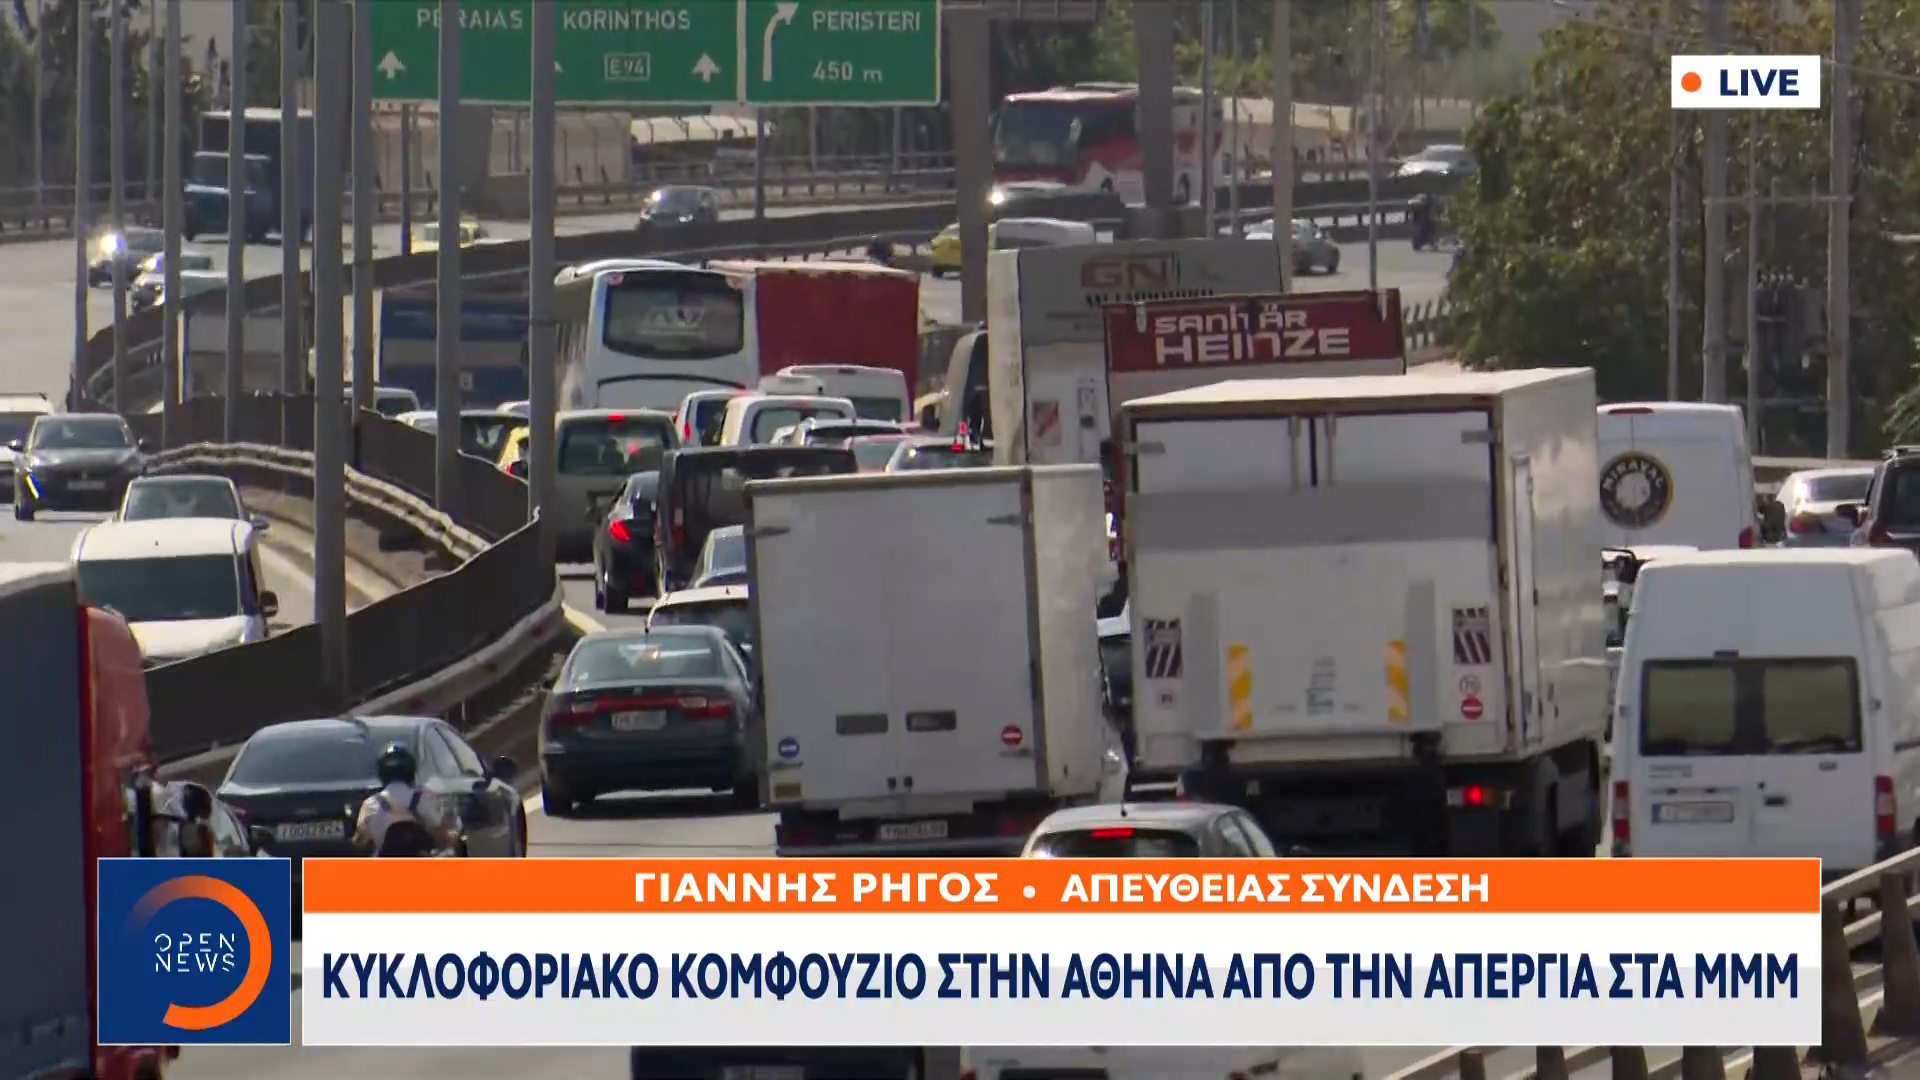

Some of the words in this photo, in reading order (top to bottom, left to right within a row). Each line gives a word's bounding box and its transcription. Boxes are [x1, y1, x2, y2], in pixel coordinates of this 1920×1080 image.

[417, 8, 522, 30] PERAIAS
[563, 9, 691, 31] KORINTHOS
[811, 10, 921, 31] PERISTERI
[811, 60, 853, 81] 450
[863, 68, 883, 82] m
